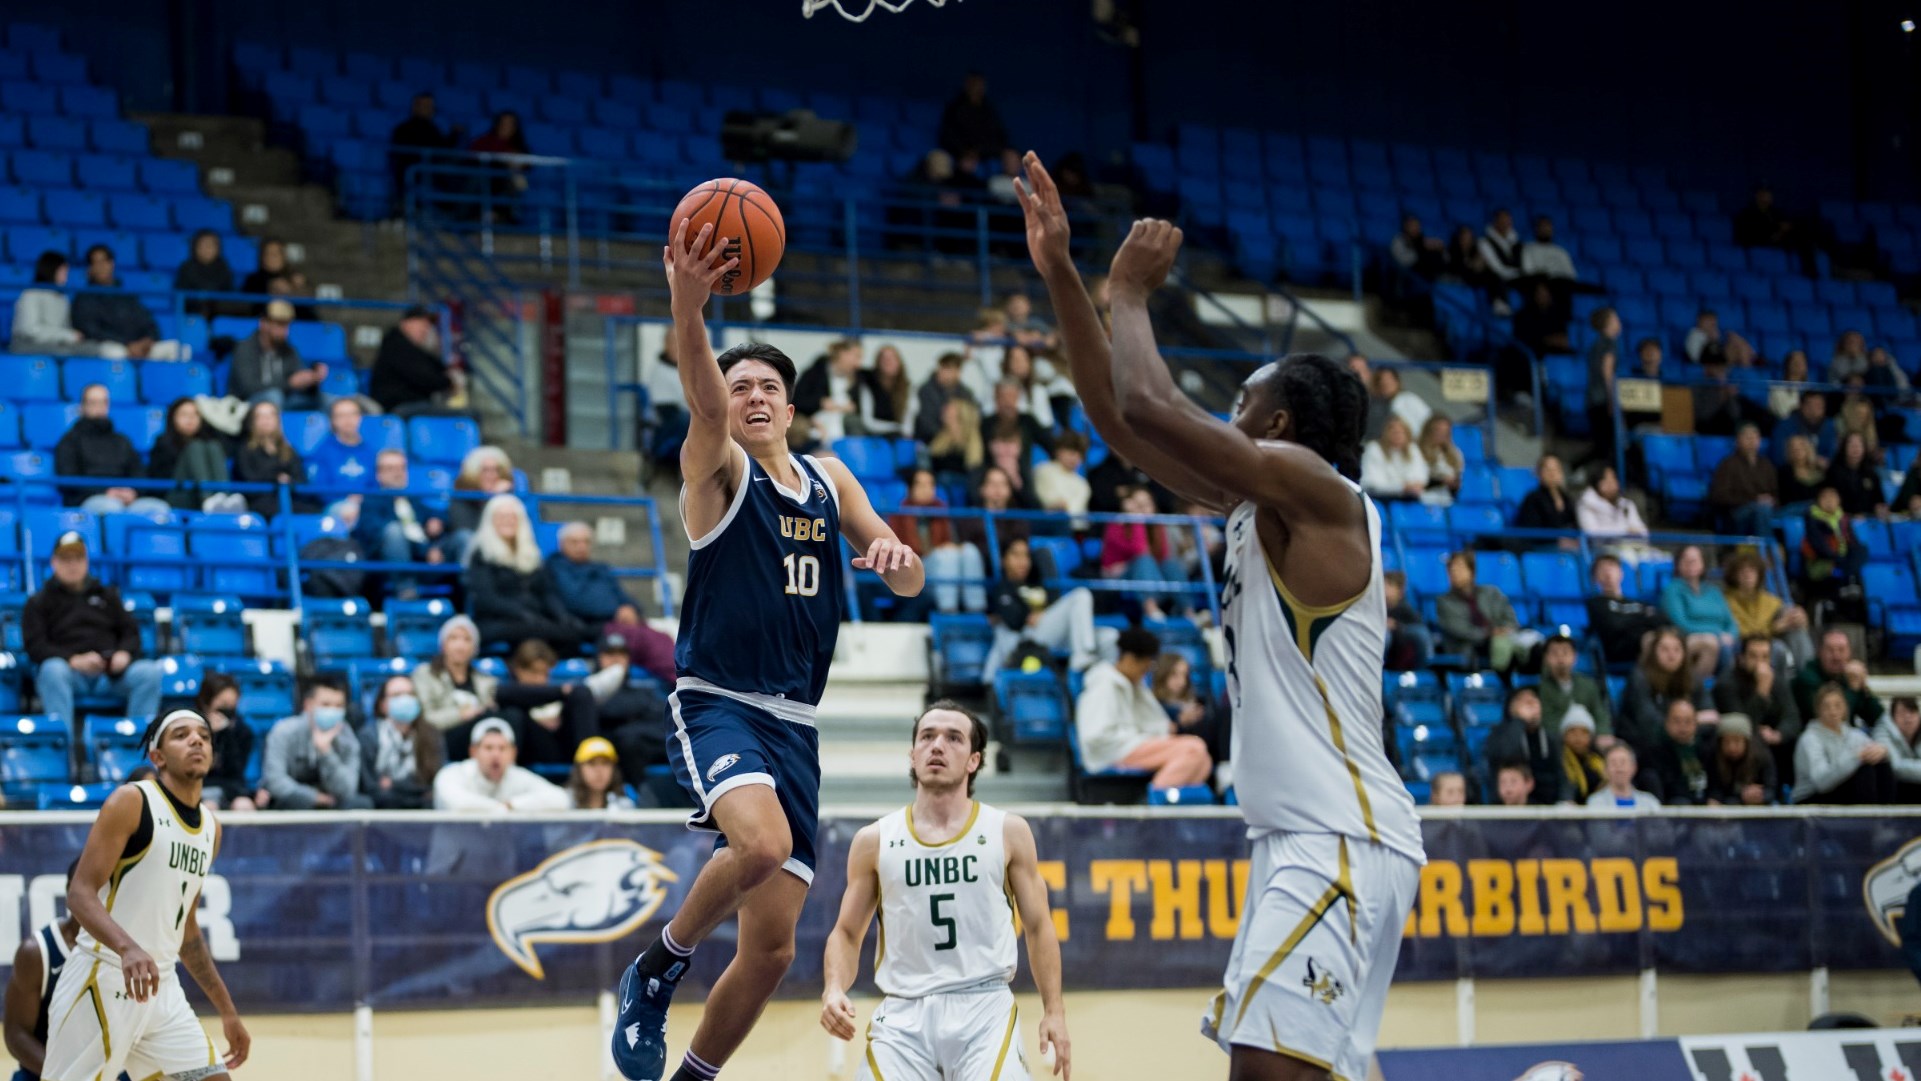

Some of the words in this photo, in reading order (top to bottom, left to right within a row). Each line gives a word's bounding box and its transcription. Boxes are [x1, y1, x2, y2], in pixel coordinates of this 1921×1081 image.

[721, 236, 742, 293] Wlso
[779, 514, 826, 541] UBC
[783, 552, 820, 596] 10
[169, 841, 207, 877] UNBC
[905, 855, 978, 886] UNBC
[1090, 857, 1685, 940] THURBIRDS
[930, 893, 957, 951] 5
